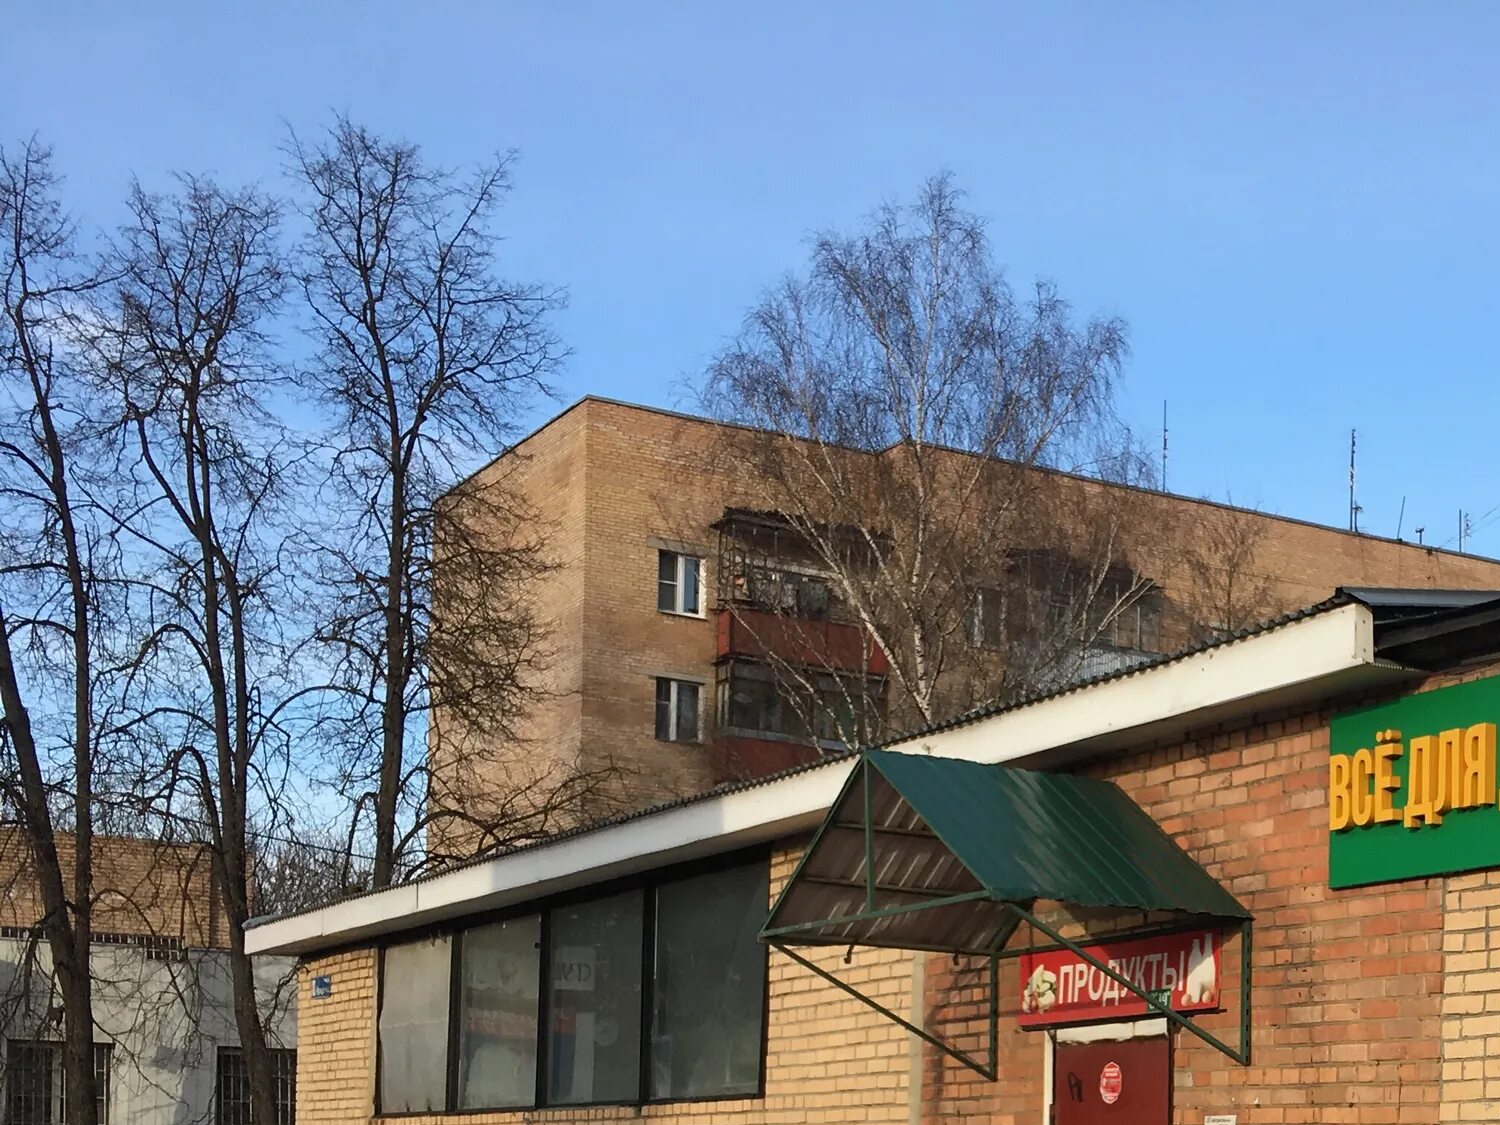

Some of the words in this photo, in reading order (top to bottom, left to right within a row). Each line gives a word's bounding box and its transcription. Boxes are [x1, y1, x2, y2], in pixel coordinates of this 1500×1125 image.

[1329, 729, 1403, 831] ВСЁ
[1403, 722, 1497, 829] ДЛЯ
[1058, 950, 1185, 1007] ПРОДУКТЫ
